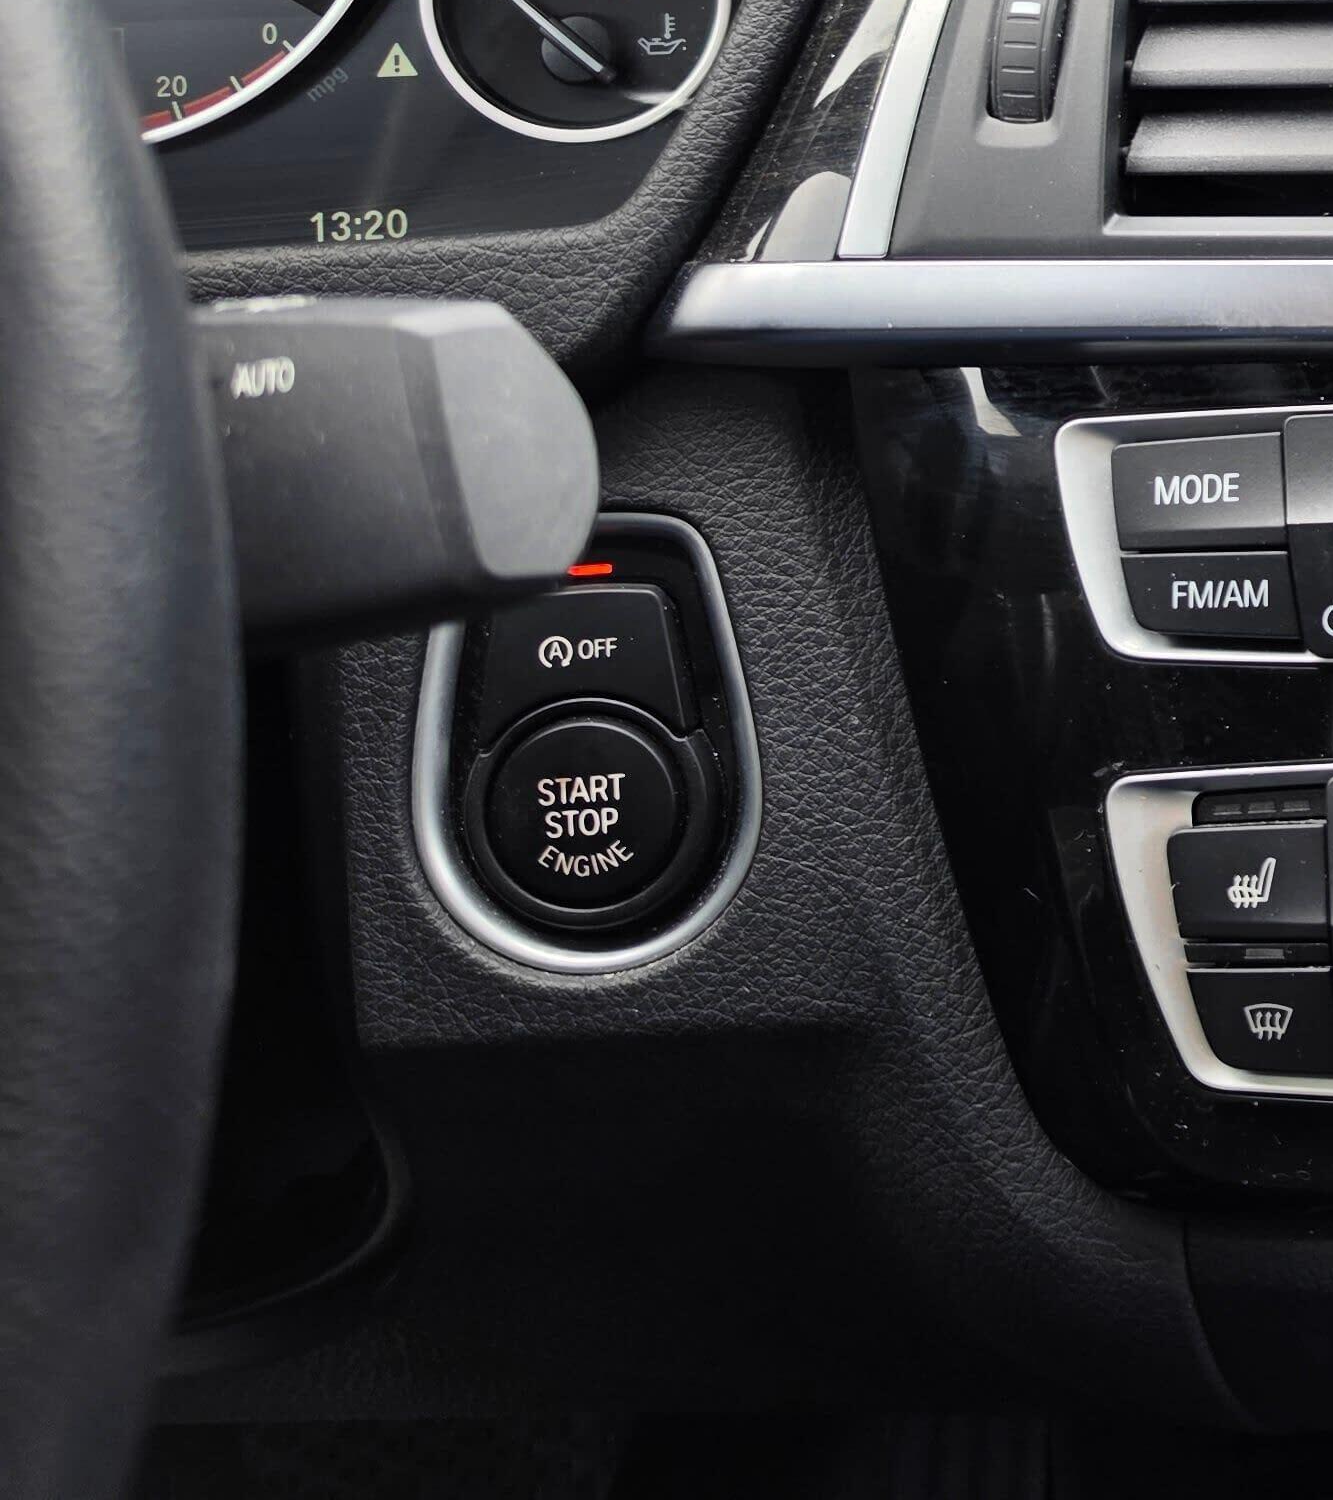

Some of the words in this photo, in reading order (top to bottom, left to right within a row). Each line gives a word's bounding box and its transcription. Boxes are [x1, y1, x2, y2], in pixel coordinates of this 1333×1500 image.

[261, 22, 279, 45] 0
[155, 74, 188, 98] 20
[306, 65, 349, 103] mpg
[308, 208, 409, 243] 13:20
[230, 355, 296, 400] AUTO
[1153, 473, 1240, 505] MODE
[1171, 579, 1270, 610] FM/AM
[577, 637, 618, 660] OFF
[537, 772, 626, 807] START
[544, 807, 620, 839] STOP
[537, 839, 635, 878] ENGINE
